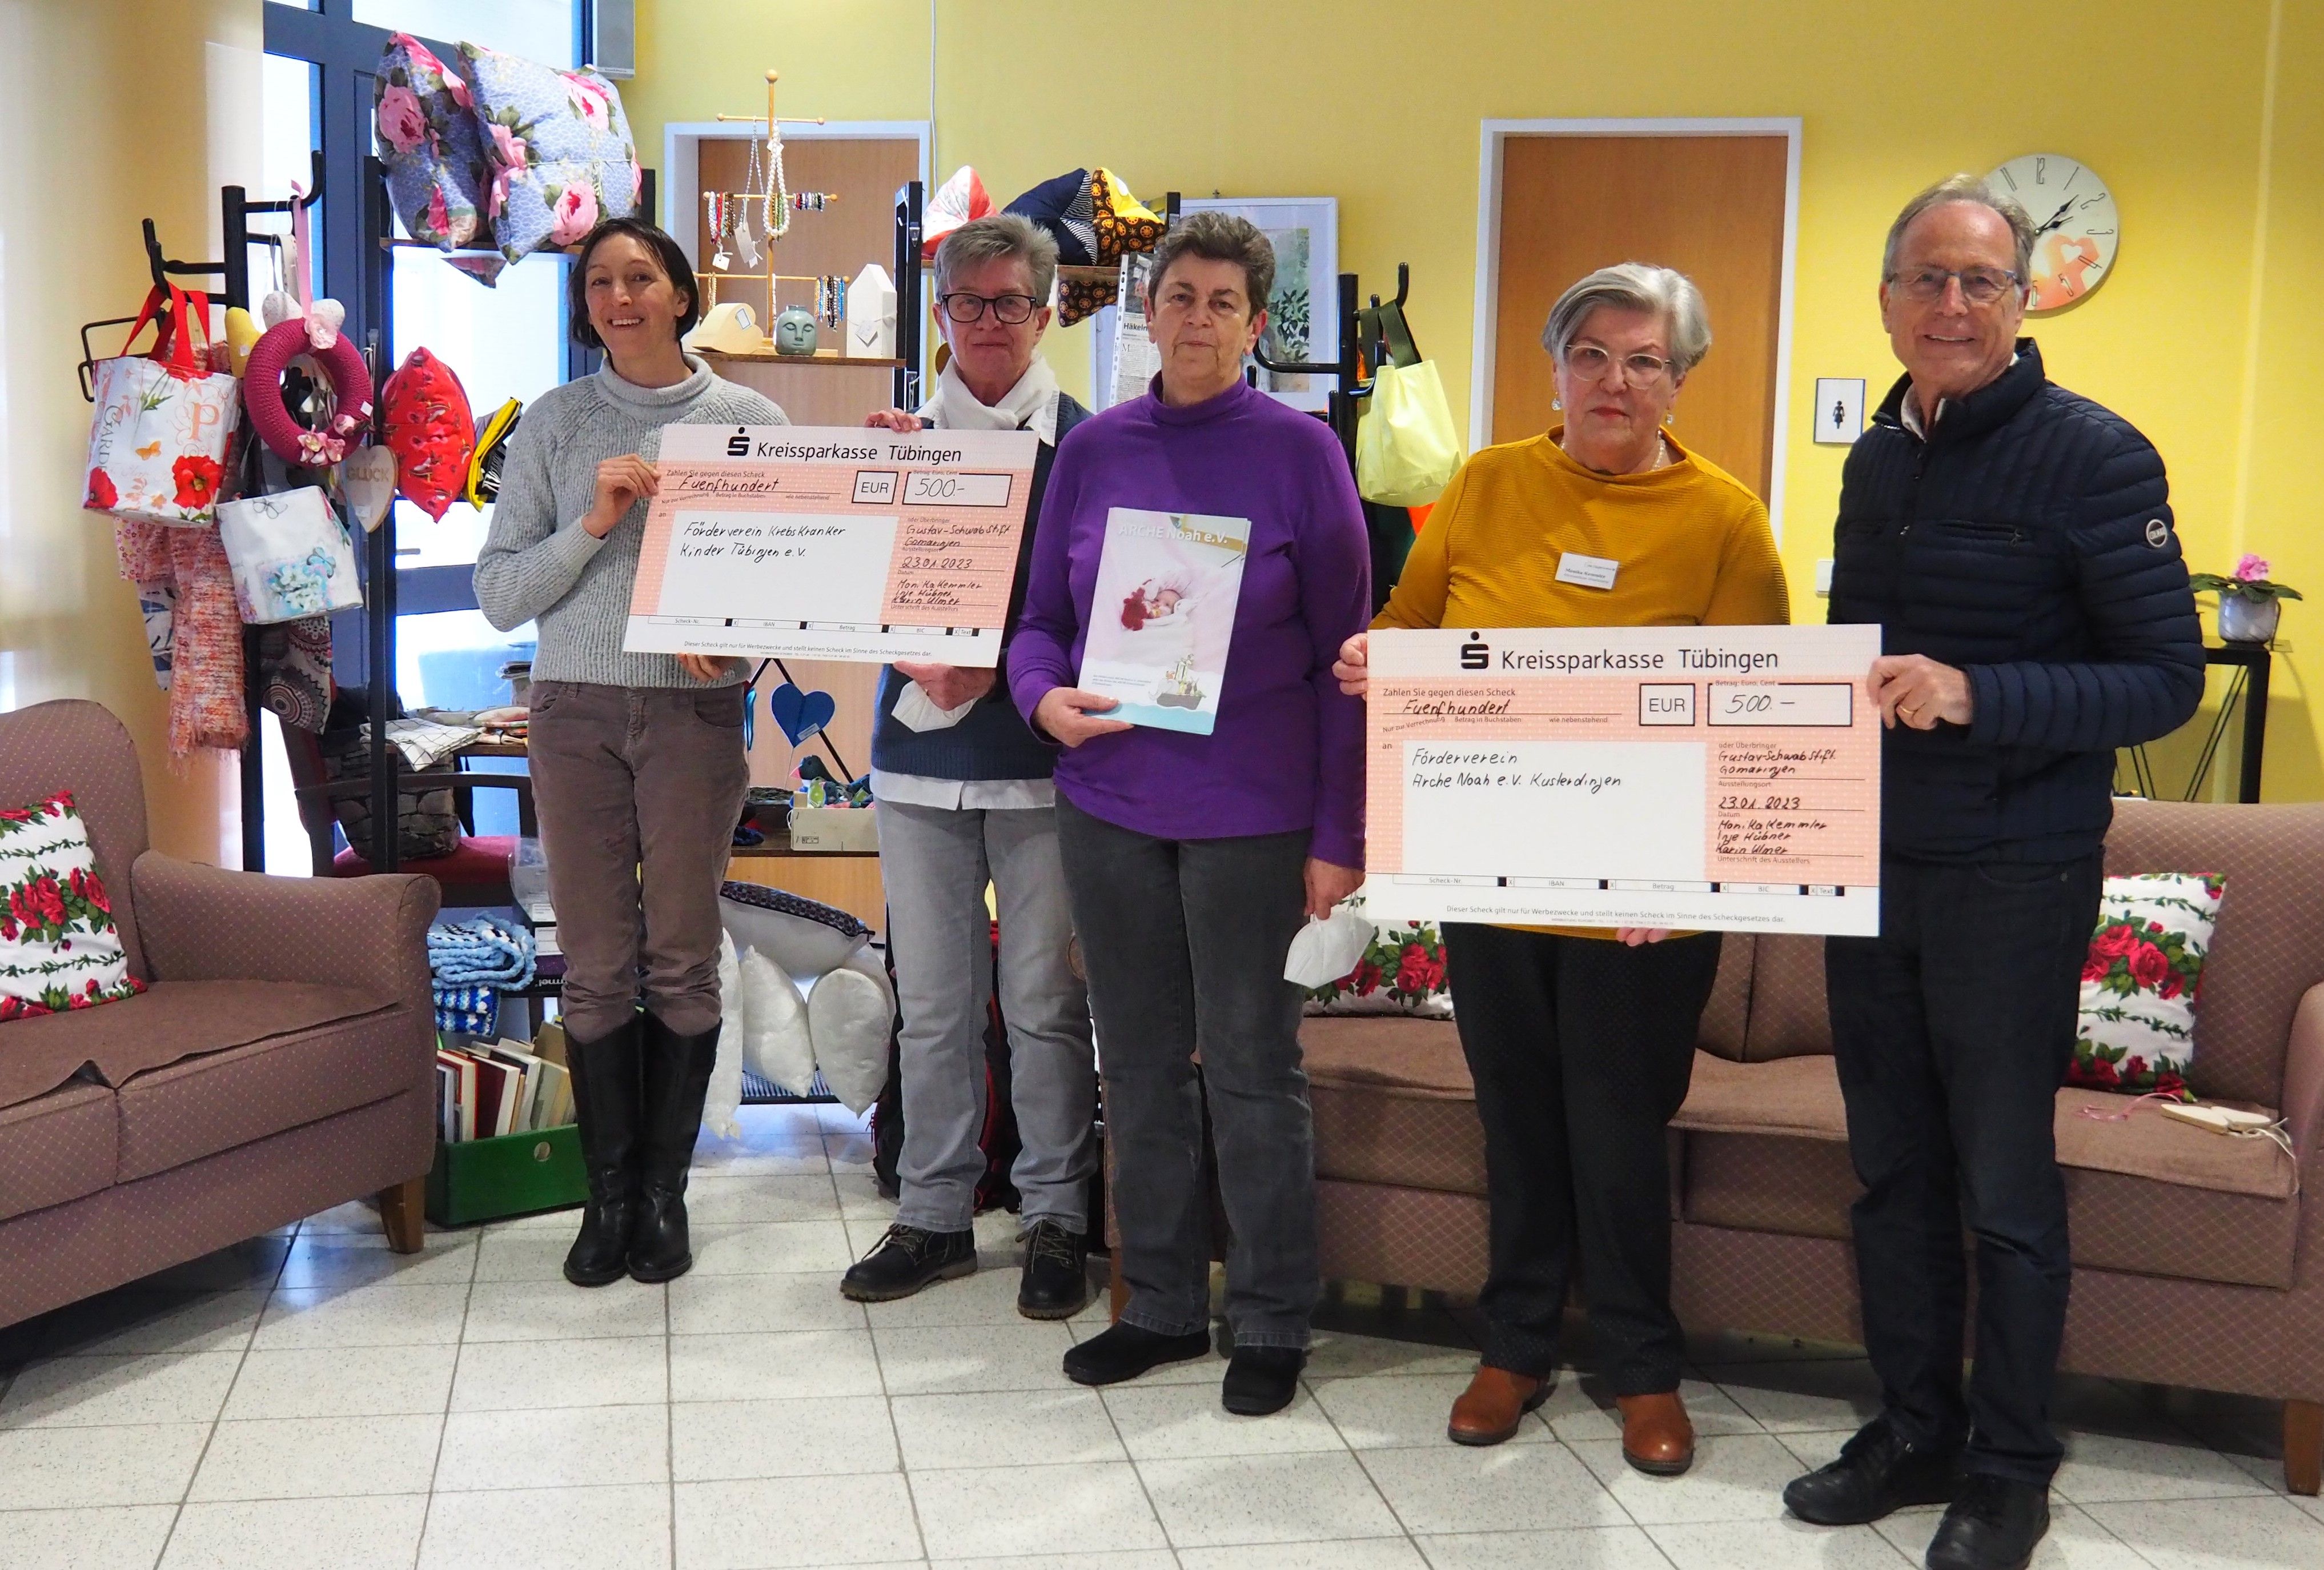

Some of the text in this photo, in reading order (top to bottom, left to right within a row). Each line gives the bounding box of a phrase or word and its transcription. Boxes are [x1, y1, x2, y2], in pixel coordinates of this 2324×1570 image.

[757, 442, 878, 462] Kreissparkasse
[889, 444, 962, 466] Tübingen
[679, 475, 780, 493] Fuenfhundert
[861, 482, 889, 494] EUR
[684, 522, 762, 536] Förderverein
[1119, 523, 1164, 539] ARCHE
[1167, 527, 1201, 541] Noah
[680, 542, 725, 557] Kinder
[730, 542, 780, 563] Tübingen
[1502, 649, 1664, 674] Kreissparkasse
[1678, 648, 1778, 673] Tübingen
[1428, 690, 1454, 698] gegen
[1456, 688, 1484, 696] diesen
[1402, 699, 1511, 716] Fuenfhundert
[1649, 698, 1685, 712] EUR
[1406, 716, 1446, 728] Verrechnung
[1735, 742, 1777, 750] Überbringer
[1412, 747, 1518, 766] Förderverein
[1412, 772, 1452, 788] Arche
[1457, 772, 1490, 787] Noah
[1652, 883, 1674, 891] Betrag
[1494, 906, 1506, 915] gilt
[1531, 908, 1579, 916] Werbezwecke
[1713, 914, 1770, 923] Scheckgesetzes
